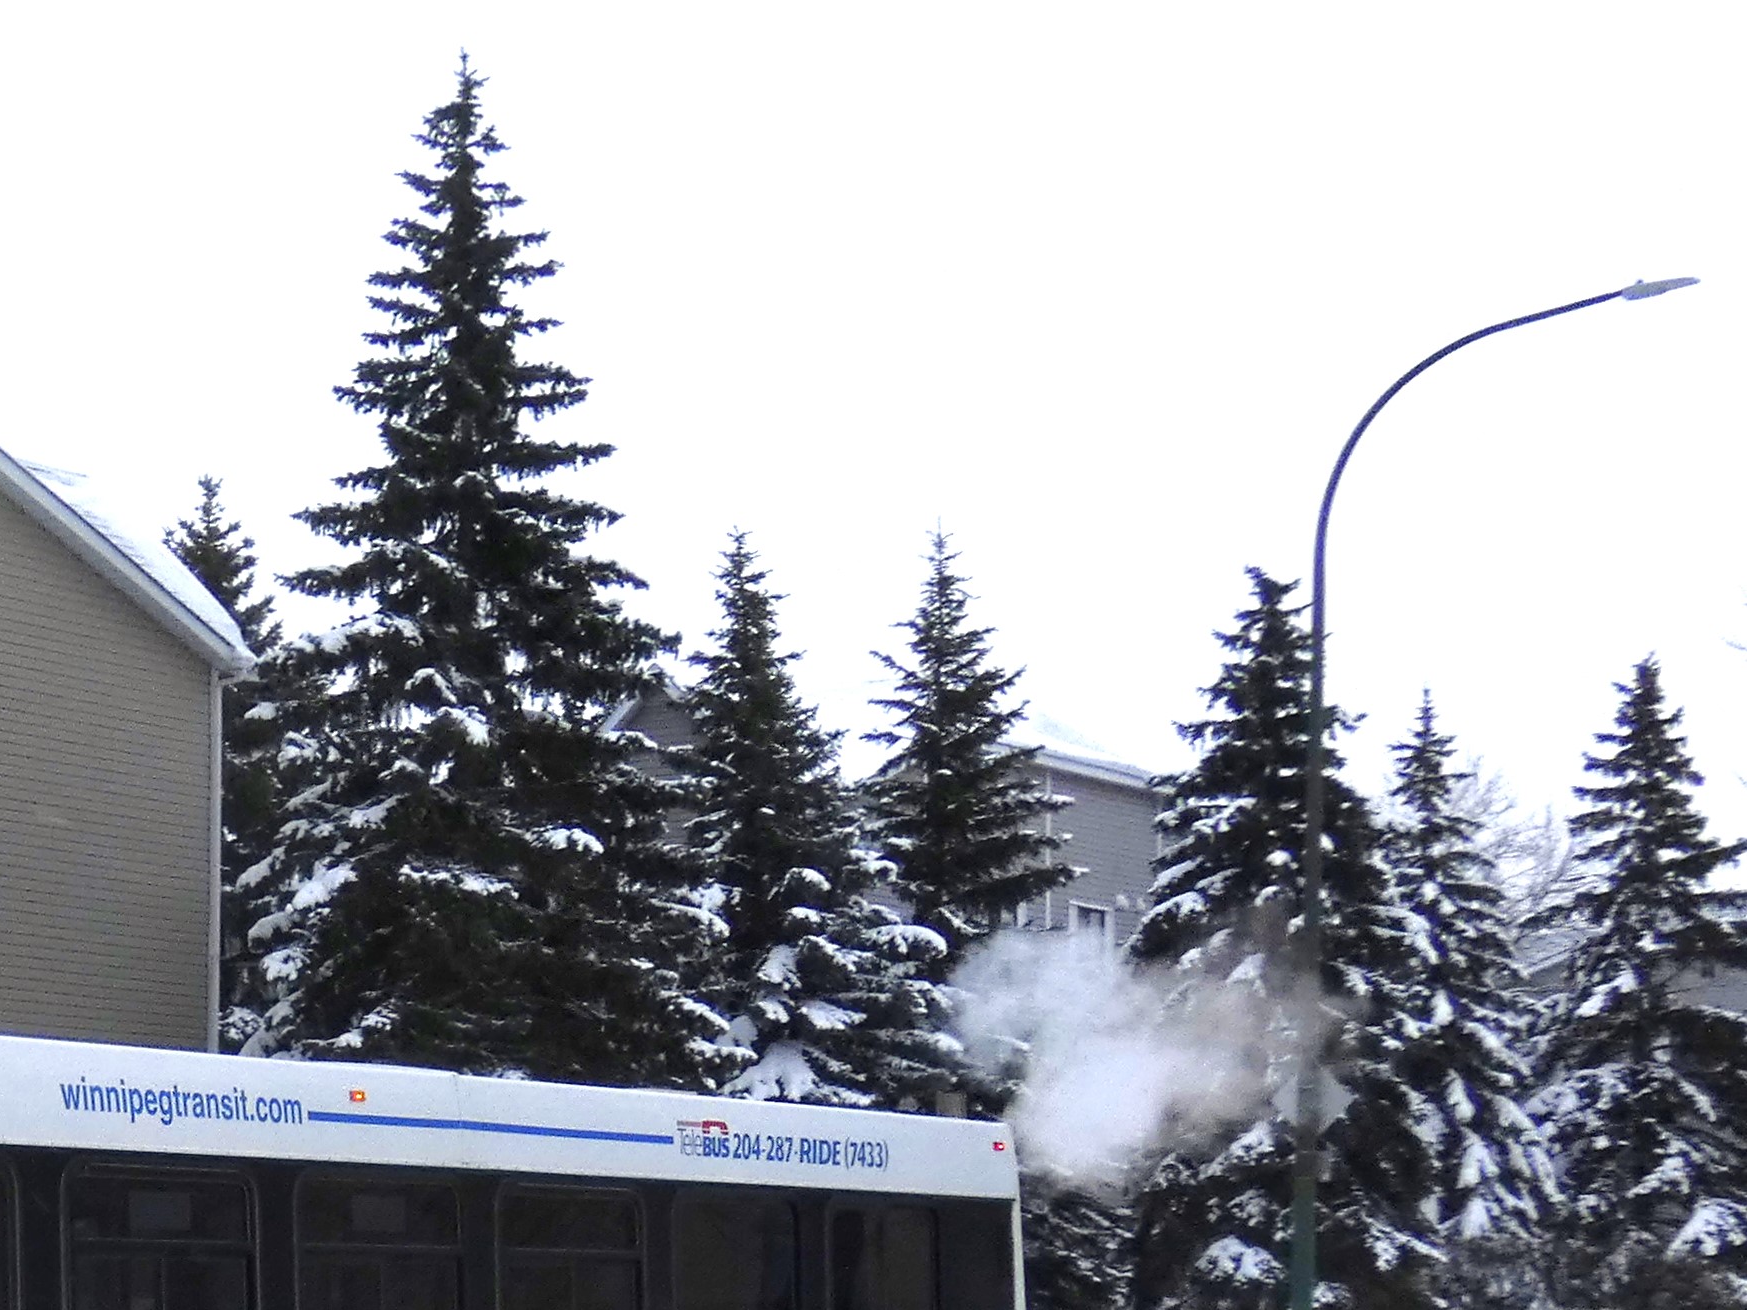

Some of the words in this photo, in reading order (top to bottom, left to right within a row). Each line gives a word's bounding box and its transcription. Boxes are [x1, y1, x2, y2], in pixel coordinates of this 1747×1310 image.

[59, 1076, 303, 1126] winnipegtransit.com
[676, 1128, 730, 1158] TeleBUS
[844, 1137, 889, 1171] (7433)
